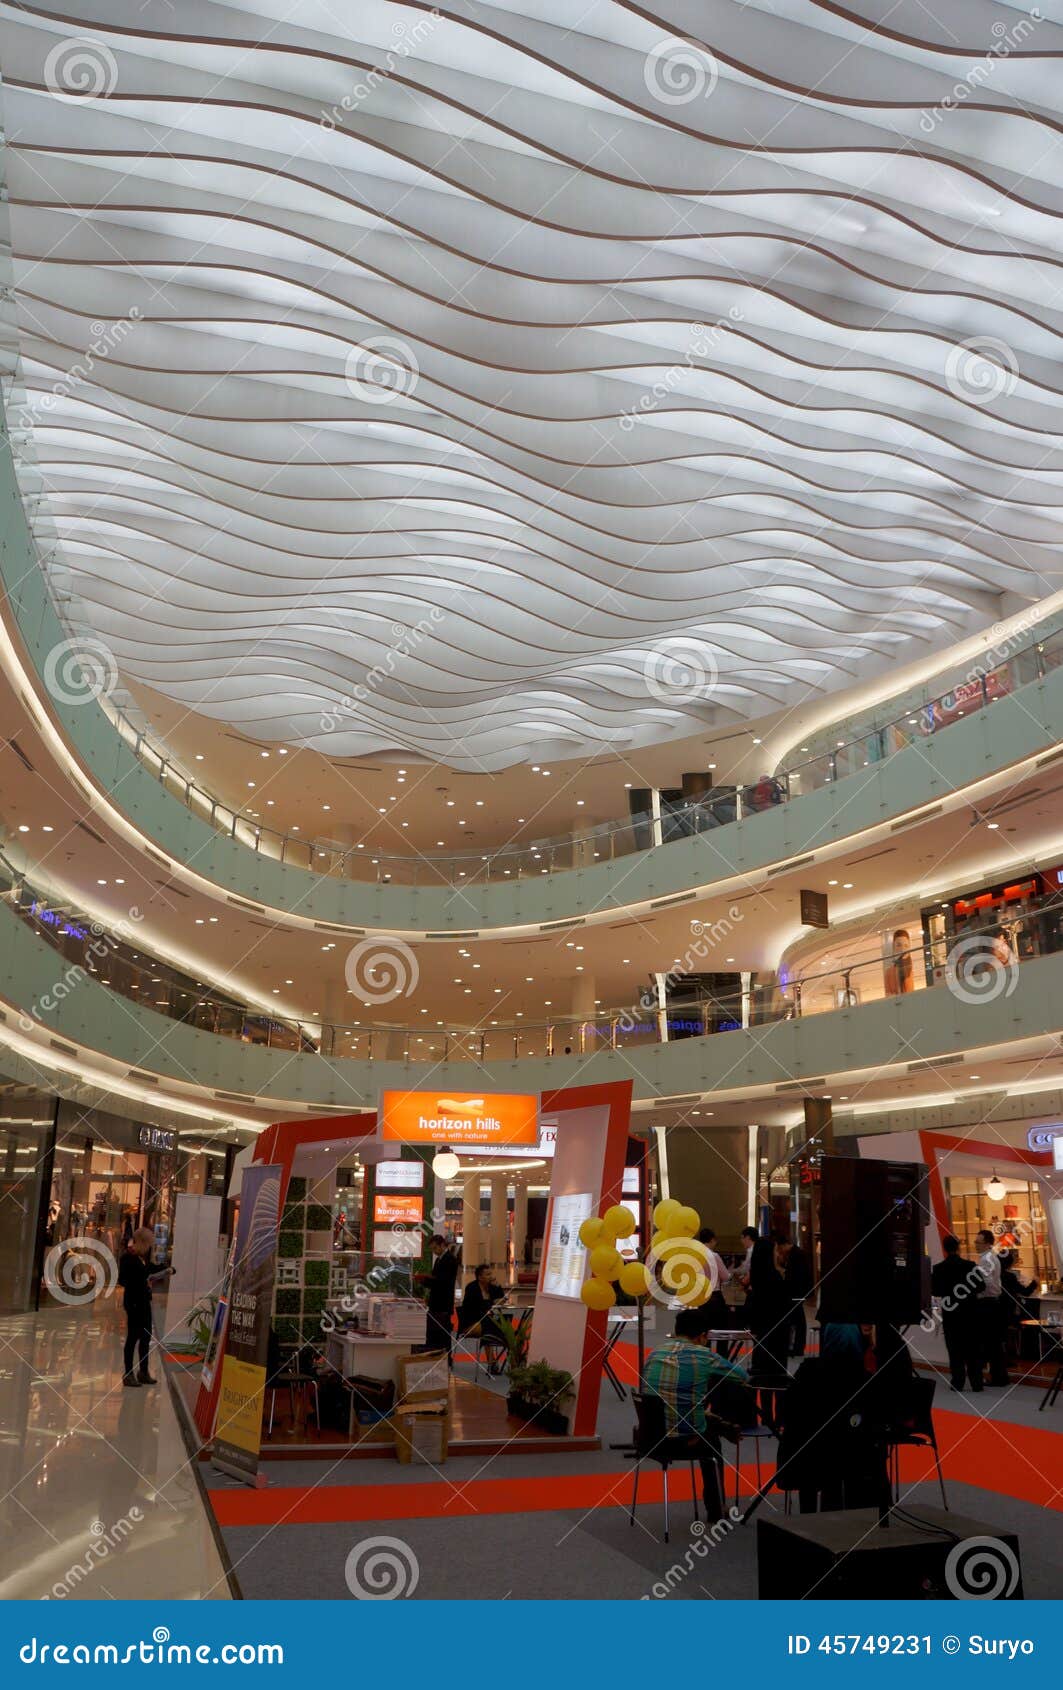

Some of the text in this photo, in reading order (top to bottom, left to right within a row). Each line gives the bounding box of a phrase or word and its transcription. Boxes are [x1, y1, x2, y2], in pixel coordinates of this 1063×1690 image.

[419, 1116, 501, 1131] horizon hills
[448, 1131, 463, 1139] with
